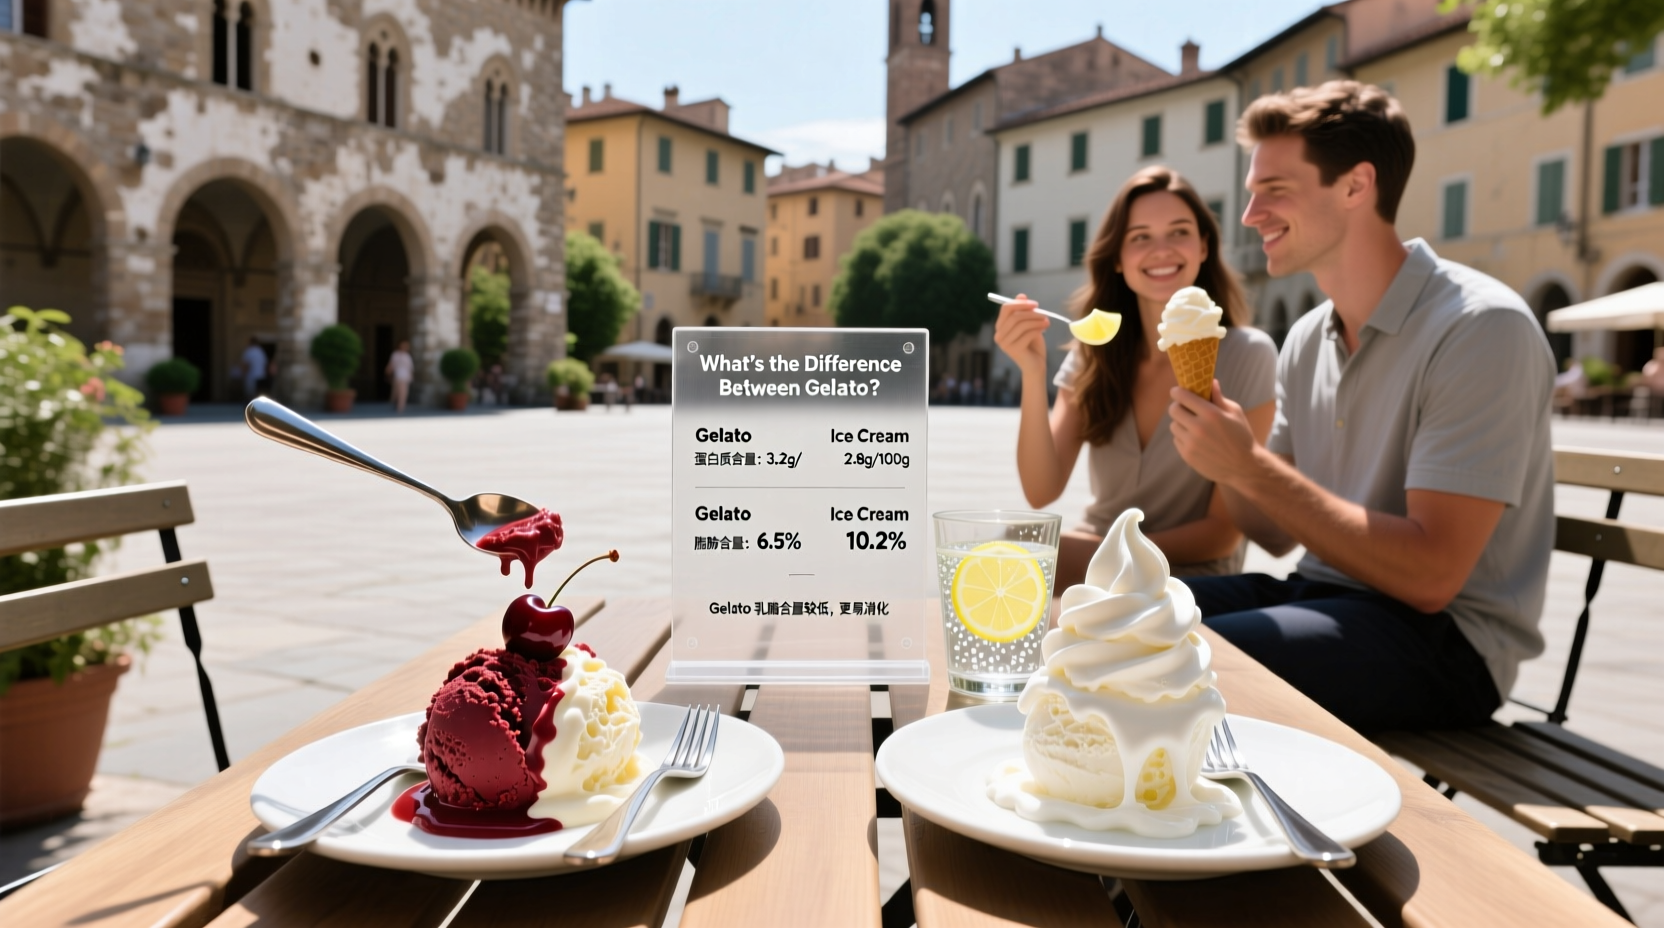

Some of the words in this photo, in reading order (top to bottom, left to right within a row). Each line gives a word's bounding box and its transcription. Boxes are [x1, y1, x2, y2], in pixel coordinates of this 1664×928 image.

[699, 353, 765, 372] What’s
[769, 354, 800, 372] the
[804, 353, 902, 373] Difference
[719, 378, 801, 397] Between
[804, 377, 881, 397] Gelato?
[695, 426, 753, 444] Gelato
[830, 428, 854, 444] Ice
[857, 427, 910, 444] Cream
[766, 451, 803, 469] 3.2g/
[843, 451, 910, 470] 2.8g/100g
[694, 505, 752, 522] Gelato
[830, 506, 854, 522] Ice
[856, 506, 910, 522] Cream
[756, 531, 802, 550] 6.5%
[845, 530, 907, 551] 10.2%
[708, 600, 752, 615] Gelato
